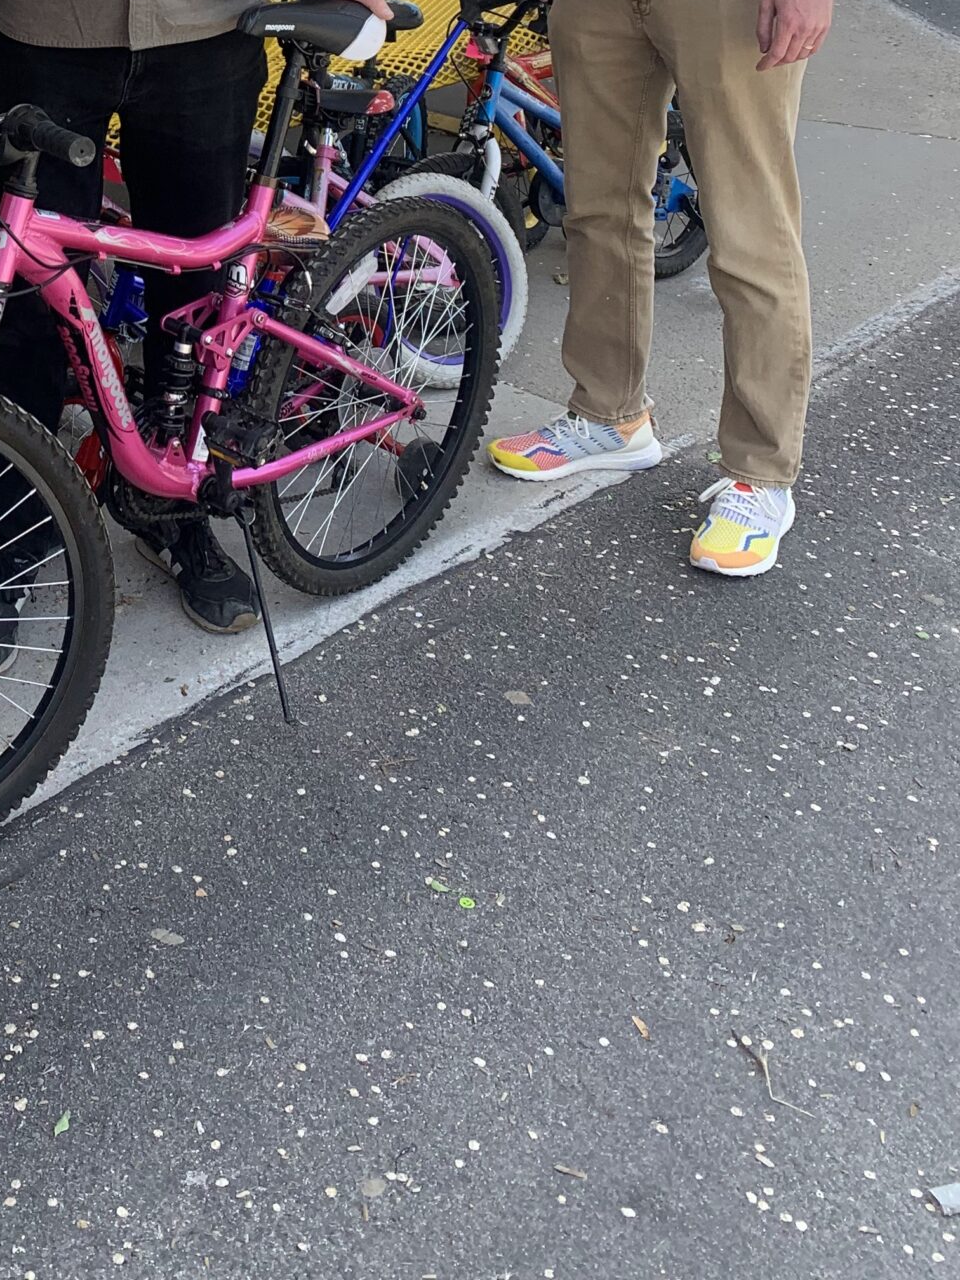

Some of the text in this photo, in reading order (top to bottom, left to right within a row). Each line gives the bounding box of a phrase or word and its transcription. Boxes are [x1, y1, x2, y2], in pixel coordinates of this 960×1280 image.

[264, 24, 295, 32] mongoose
[109, 272, 121, 296] STAR
[88, 323, 133, 429] mongoose
